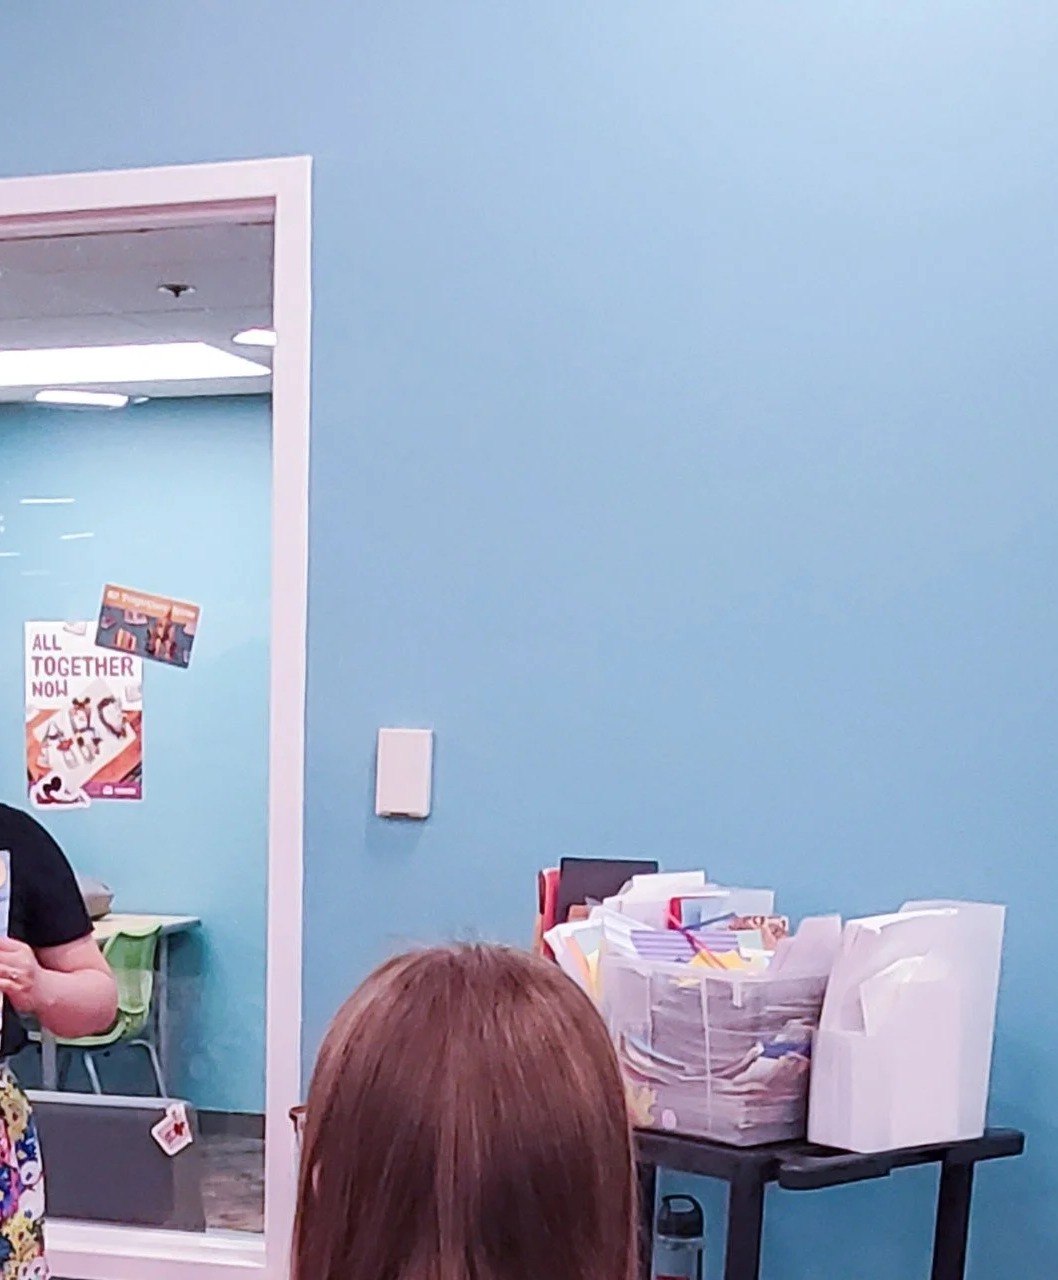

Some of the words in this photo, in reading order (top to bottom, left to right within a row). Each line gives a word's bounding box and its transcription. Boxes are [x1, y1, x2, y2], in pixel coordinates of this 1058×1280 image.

[32, 633, 62, 651] ALL
[31, 656, 134, 677] TOGETHER
[31, 679, 68, 697] NOW
